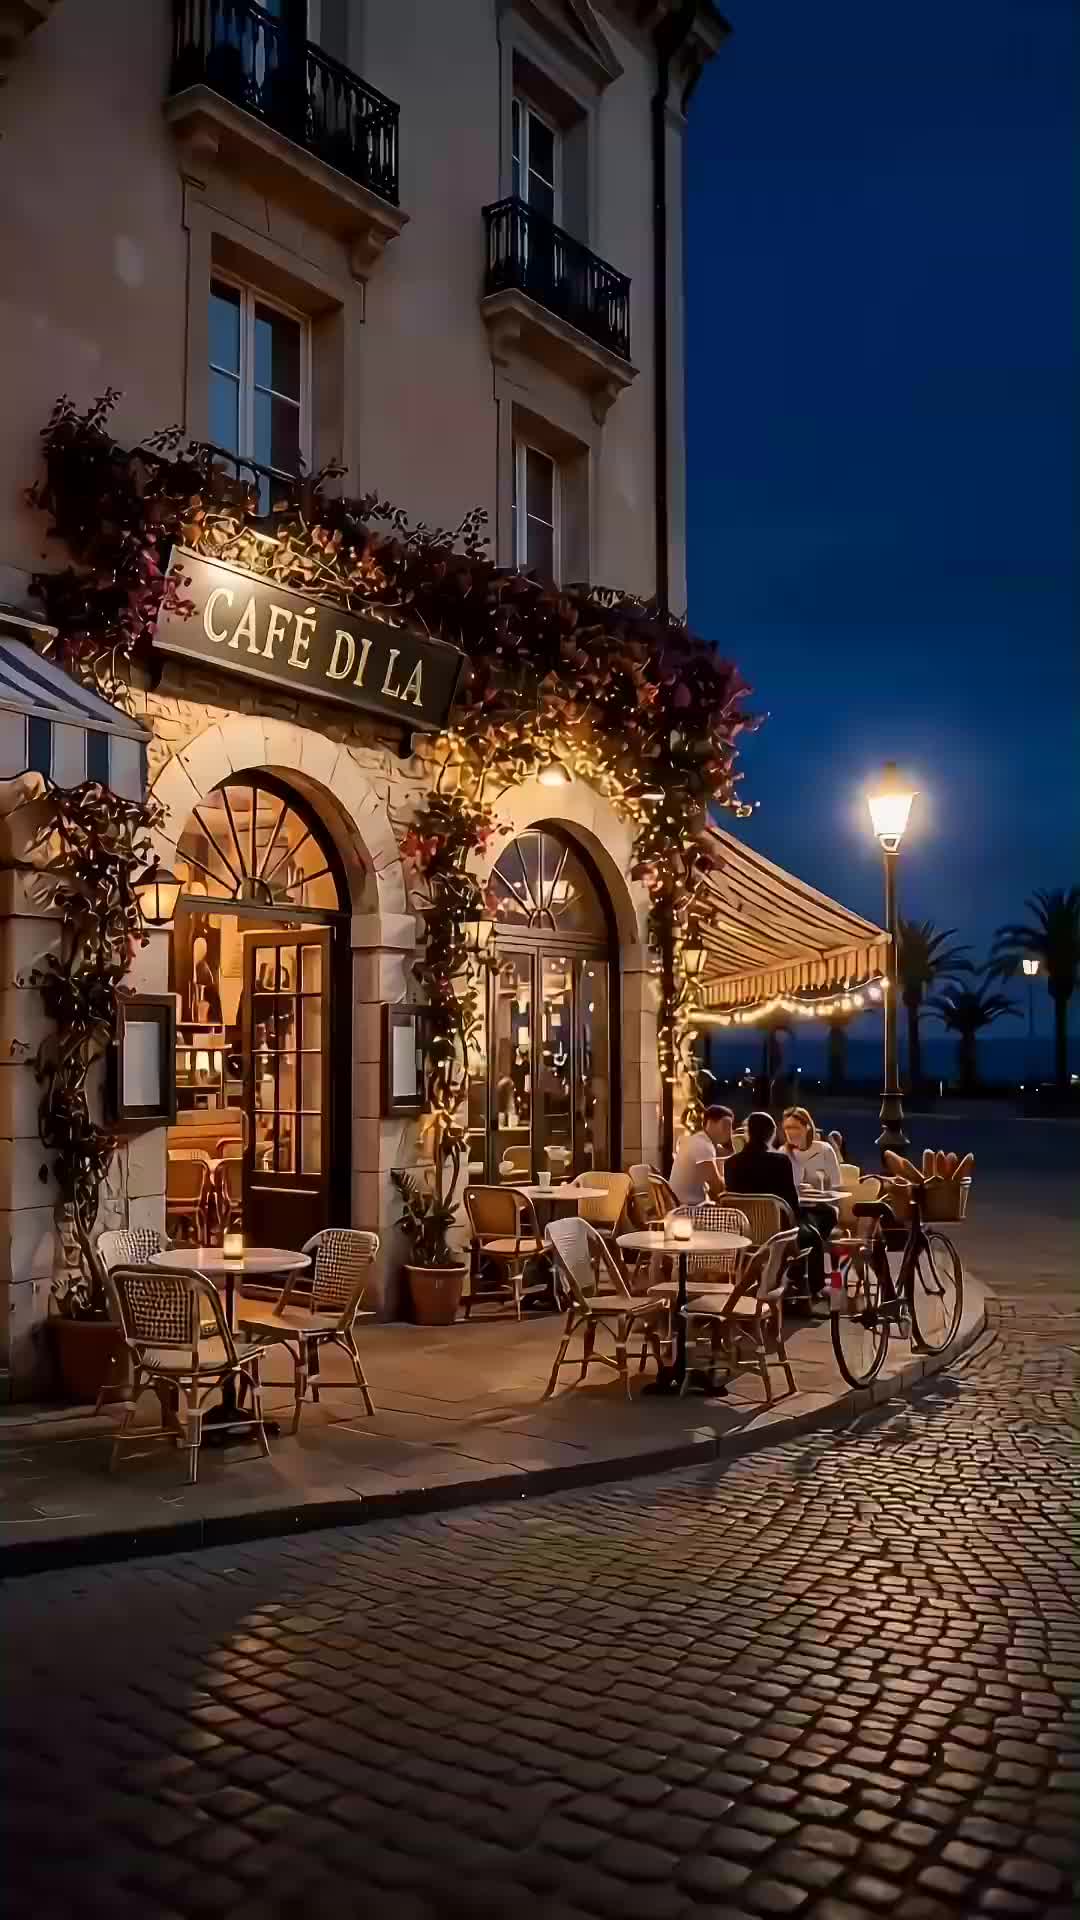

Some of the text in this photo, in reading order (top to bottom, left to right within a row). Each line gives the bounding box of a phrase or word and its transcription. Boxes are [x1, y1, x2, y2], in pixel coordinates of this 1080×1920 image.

[203, 588, 423, 706] CAFÉ DI LA
